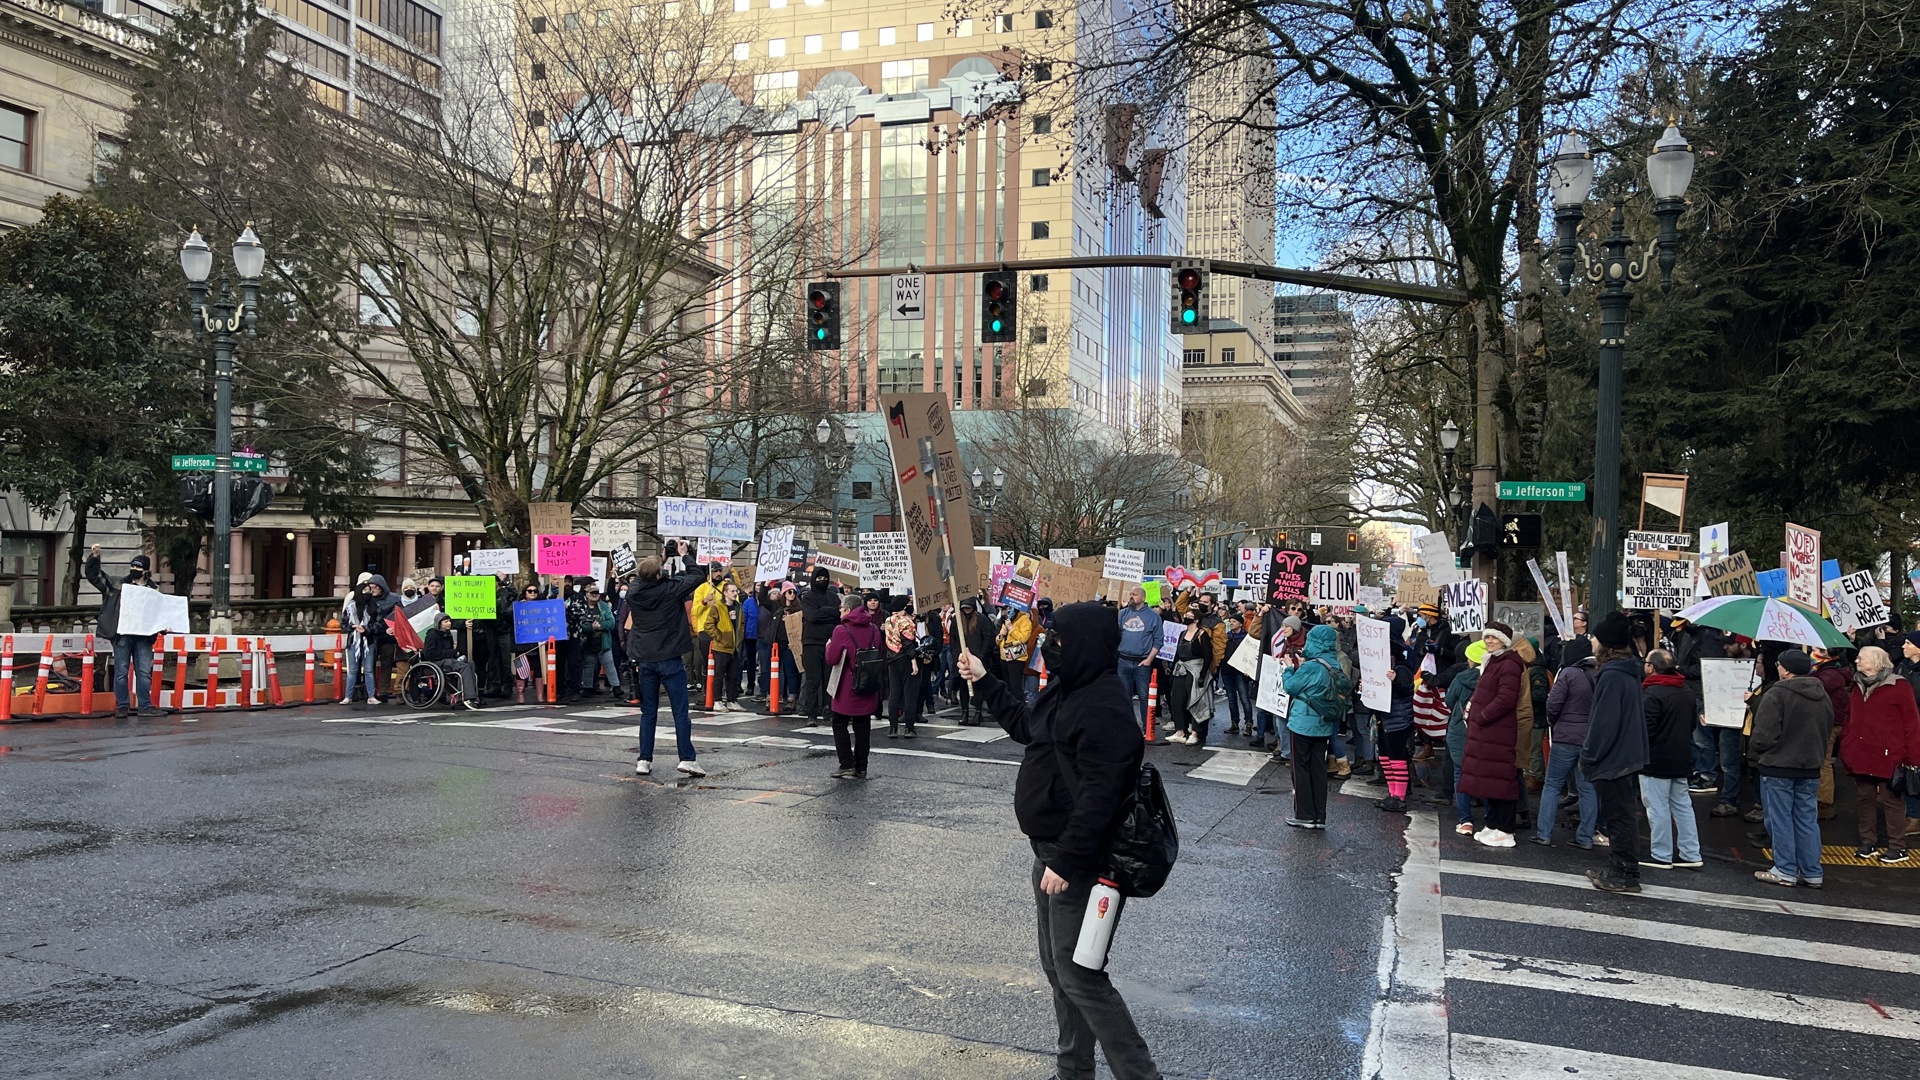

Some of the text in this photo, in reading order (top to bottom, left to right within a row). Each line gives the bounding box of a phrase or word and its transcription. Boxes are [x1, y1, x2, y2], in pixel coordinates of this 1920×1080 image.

[897, 277, 920, 288] ONE
[896, 290, 921, 300] WAY
[182, 458, 210, 467] Jefferson
[939, 456, 956, 471] BLACK
[942, 470, 957, 485] LIVES
[945, 486, 963, 499] MATTER
[1502, 488, 1512, 496] SW
[1516, 485, 1565, 497] Jefferson
[532, 505, 565, 516] THEY
[664, 500, 750, 518] Honk if you think
[534, 519, 554, 529] WILL
[592, 520, 630, 529] NO GODS
[664, 516, 748, 530] Elon hacked the election
[763, 526, 792, 544] STOP
[1628, 532, 1690, 546] ENOUGH ALREADY!
[1788, 530, 1802, 550] NO
[542, 537, 577, 548] DEPORT
[767, 542, 783, 552] THIS
[546, 550, 568, 558] ELON
[760, 550, 788, 566] COUP
[472, 560, 512, 568] FASCISM
[816, 555, 840, 568] AMERICA
[840, 560, 851, 570] HAS
[1118, 559, 1143, 568] BREAKING
[1626, 560, 1689, 570] NO CRIMINAL SCUM
[1704, 555, 1746, 581] LEON CAN
[764, 564, 782, 574] NOW!
[1057, 567, 1098, 583] EMPATHY
[1108, 570, 1137, 580] SOCIOPATH
[1120, 566, 1142, 574] NOTHING
[1626, 568, 1689, 578] SHALL EVER RULE
[1790, 561, 1800, 580] NO
[1279, 572, 1301, 580] THIS
[1401, 575, 1428, 584] NO HUM
[1068, 581, 1085, 589] NOT
[1275, 579, 1306, 588] MACHINE
[1319, 571, 1354, 601] ELON
[1640, 578, 1672, 587] OVER US
[1842, 571, 1874, 594] ELON
[1054, 586, 1092, 600] APATHY
[1279, 586, 1300, 594] KILLS
[1446, 580, 1480, 607] MUSK
[1625, 586, 1691, 596] NO SUBMISSION TO
[1398, 591, 1436, 604] ILLEGAL
[1633, 596, 1686, 608] TRAITORS!
[1855, 592, 1872, 609] GO
[1450, 611, 1468, 632] MUST
[1469, 608, 1482, 630] GO
[1766, 609, 1800, 623] TAX
[1855, 605, 1886, 626] HOME
[1359, 620, 1384, 639] RESIST
[1774, 622, 1788, 630] THE
[1768, 625, 1808, 640] RICH
